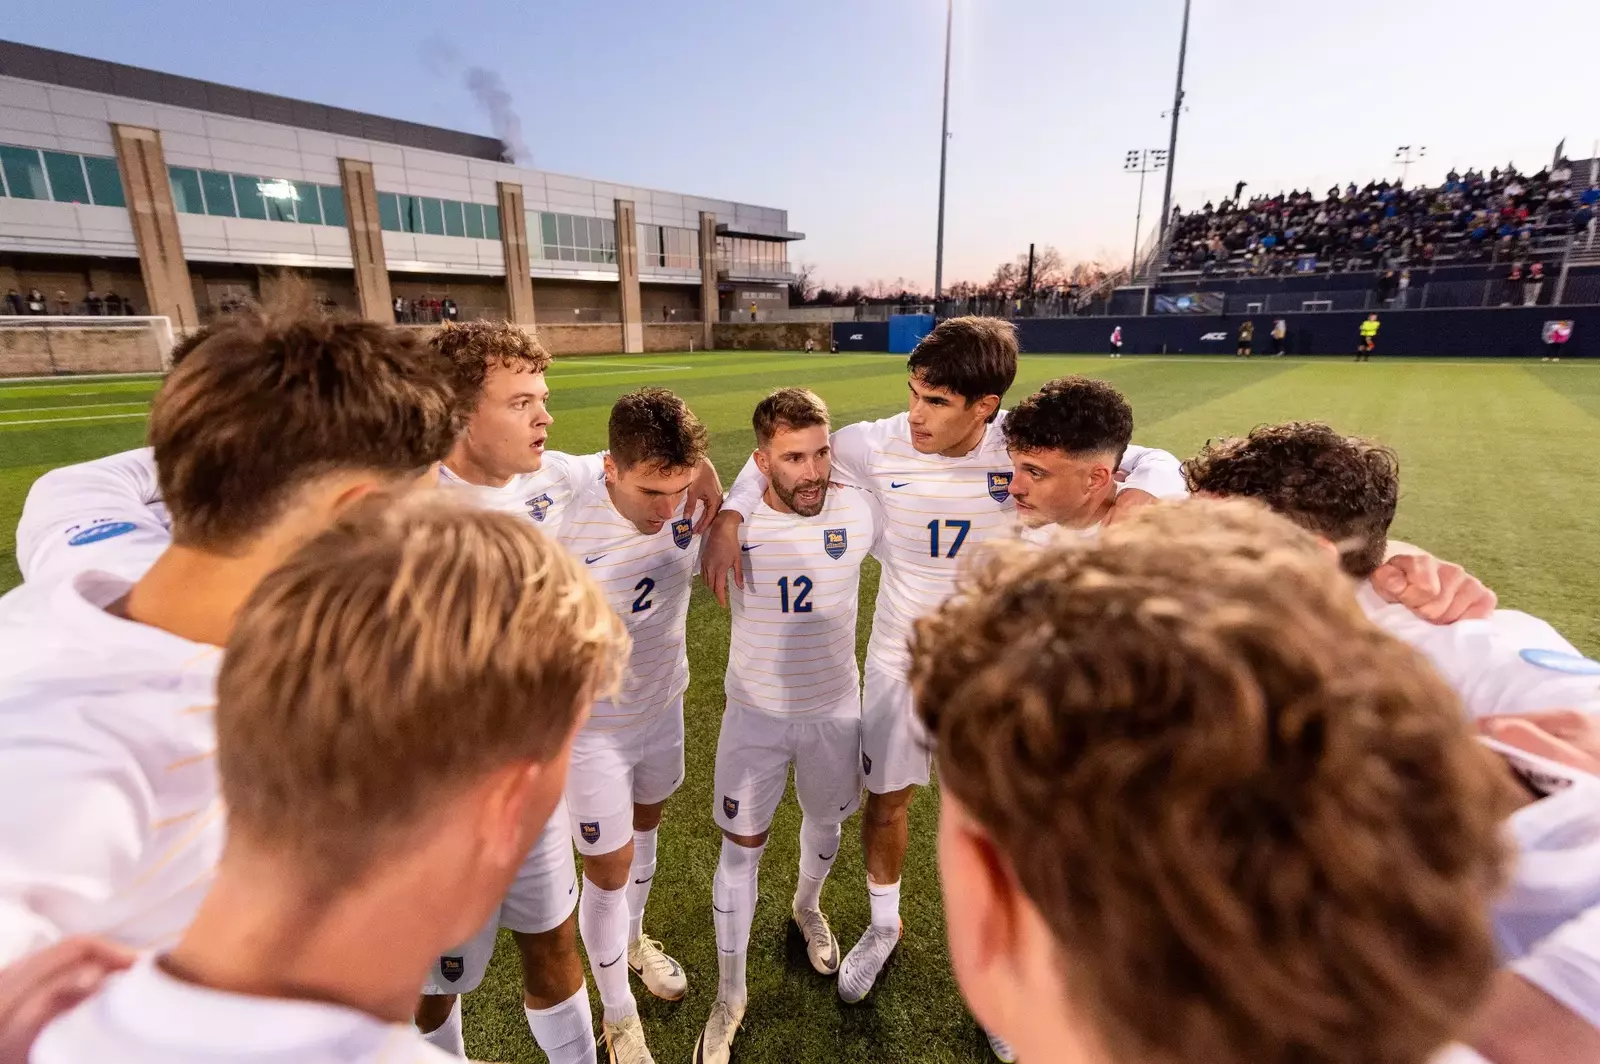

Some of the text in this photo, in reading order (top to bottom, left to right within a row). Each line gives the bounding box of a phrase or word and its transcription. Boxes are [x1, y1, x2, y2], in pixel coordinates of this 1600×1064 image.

[927, 519, 971, 558] 17
[631, 577, 656, 614] 2
[777, 575, 813, 613] 12
